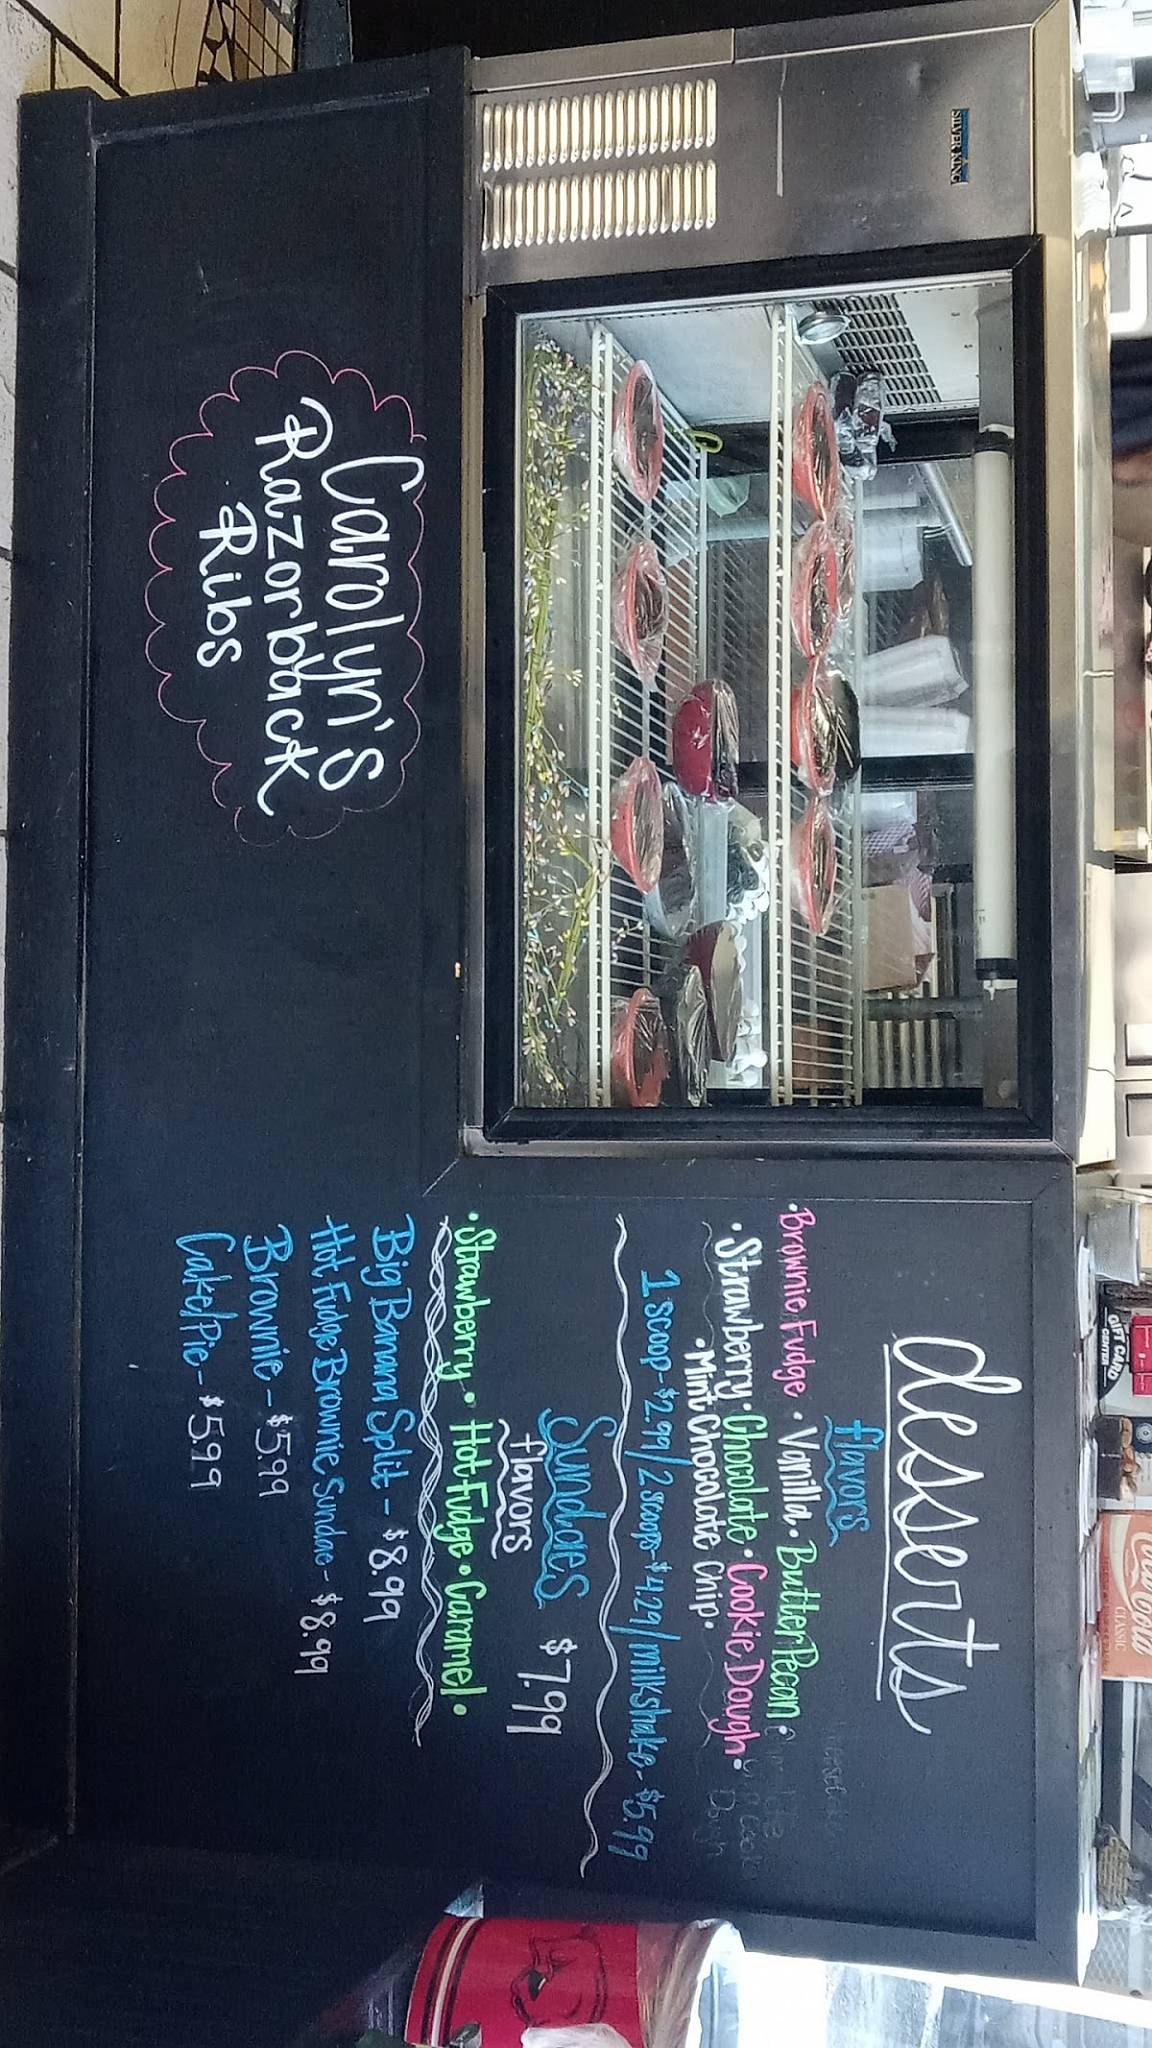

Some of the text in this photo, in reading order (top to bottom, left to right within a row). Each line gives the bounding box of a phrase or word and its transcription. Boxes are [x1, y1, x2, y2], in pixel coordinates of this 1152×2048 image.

[951, 110, 962, 183] SILVER KING
[196, 502, 258, 669] Ribs
[254, 397, 333, 816] Razorback
[292, 456, 425, 791] Carolyn's
[309, 1214, 356, 1279] Hot
[360, 1214, 415, 1288] Big
[641, 1269, 682, 1298] 1
[778, 1208, 816, 1313] Brownie
[243, 1224, 294, 1381] Brownie
[307, 1281, 352, 1352] Fudge
[368, 1287, 414, 1403] Banana
[714, 1238, 764, 1400] Strawberry
[1100, 1328, 1109, 1366] CENTER
[1107, 1314, 1127, 1381] GIFT CARD
[771, 1320, 817, 1398] Fudge
[187, 1395, 225, 1491] $5.99
[255, 1414, 294, 1497] $5.99
[311, 1348, 349, 1475] Brownie
[362, 1408, 416, 1490] Split
[432, 1227, 497, 1696] Strawberry Hot Fudge Caramel
[503, 1433, 547, 1552] flavors
[684, 1351, 726, 1617] Mint Chocolate Chip
[722, 1414, 769, 1544] Chocolate
[777, 1427, 822, 1525] Vanilla
[834, 1420, 885, 1532] flavors
[363, 1528, 410, 1623] $8.99
[505, 1415, 617, 1736] Sundaes $7.99
[888, 1333, 1023, 1735] desserts
[294, 1592, 345, 1676] $8.99
[725, 1563, 768, 1659] Cookie
[776, 1541, 820, 1643] Butter
[1114, 1606, 1127, 1650] CLASSIC
[708, 1659, 765, 1755] Dough
[767, 1643, 819, 1719] Pecan
[607, 1788, 664, 1861] $5.99
